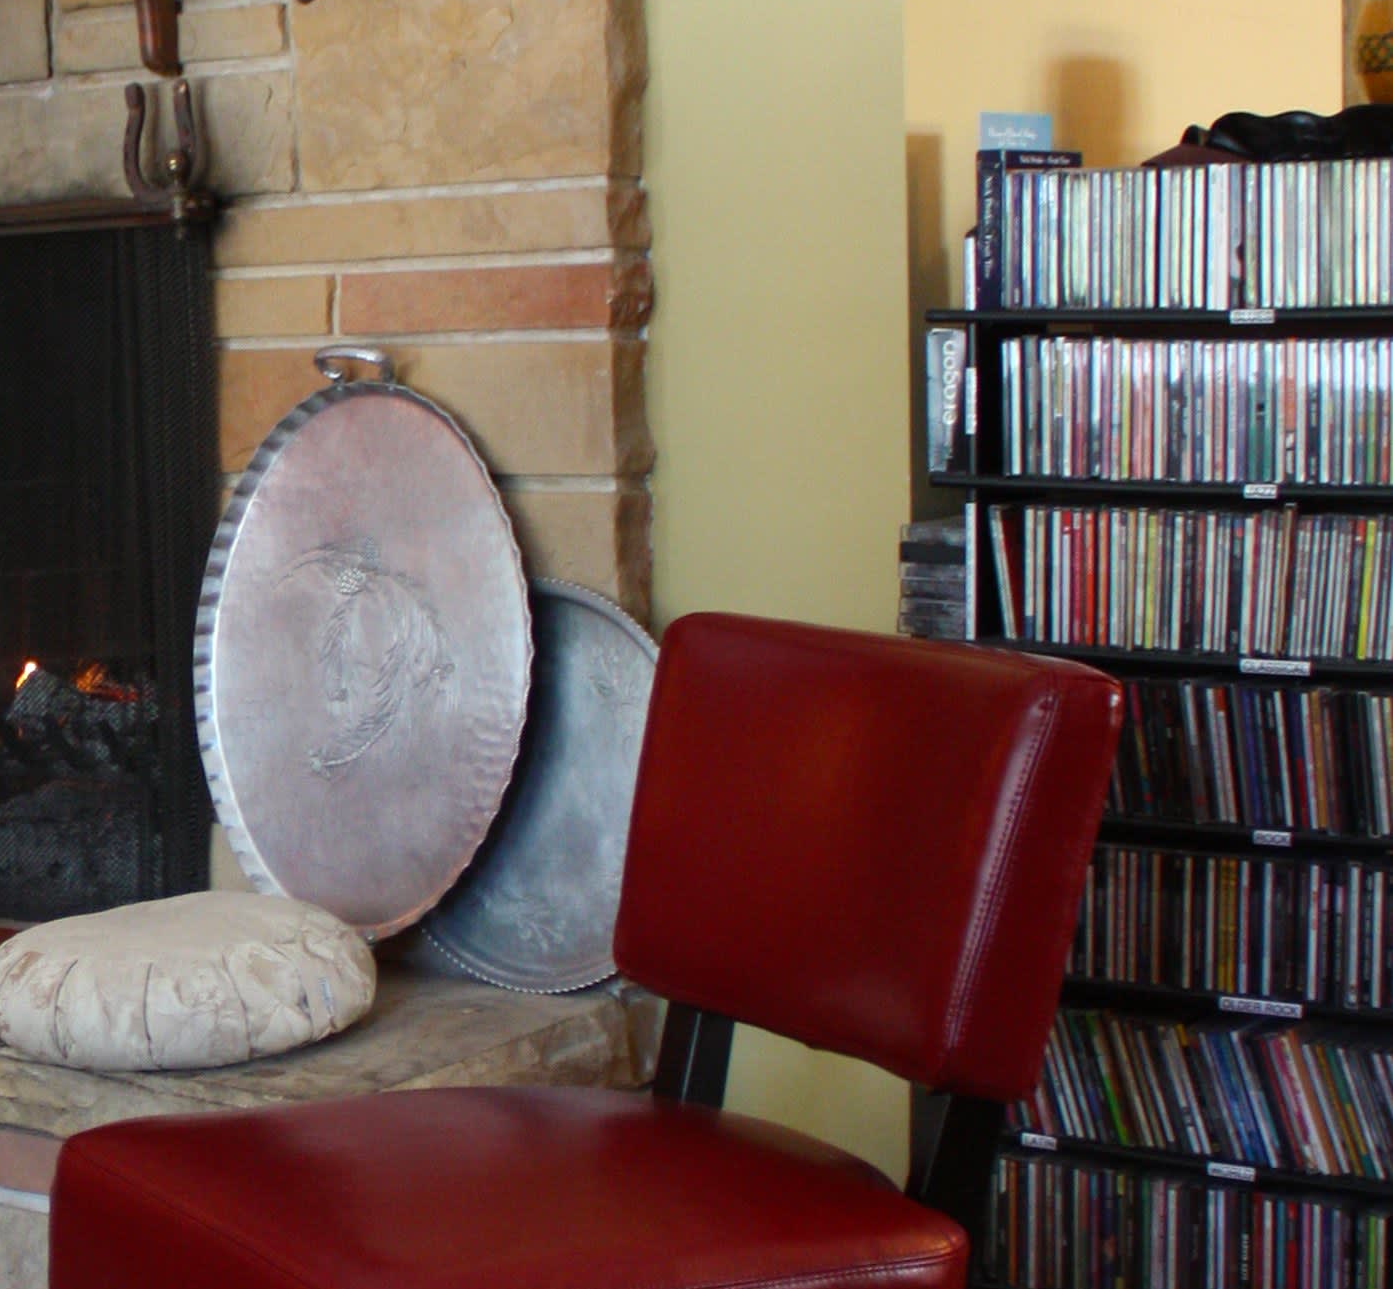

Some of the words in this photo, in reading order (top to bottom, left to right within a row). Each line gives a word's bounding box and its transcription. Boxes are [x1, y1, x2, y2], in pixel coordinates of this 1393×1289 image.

[942, 340, 960, 425] eragon
[1222, 998, 1261, 1013] OLDER
[1265, 1002, 1296, 1016] ROCK
